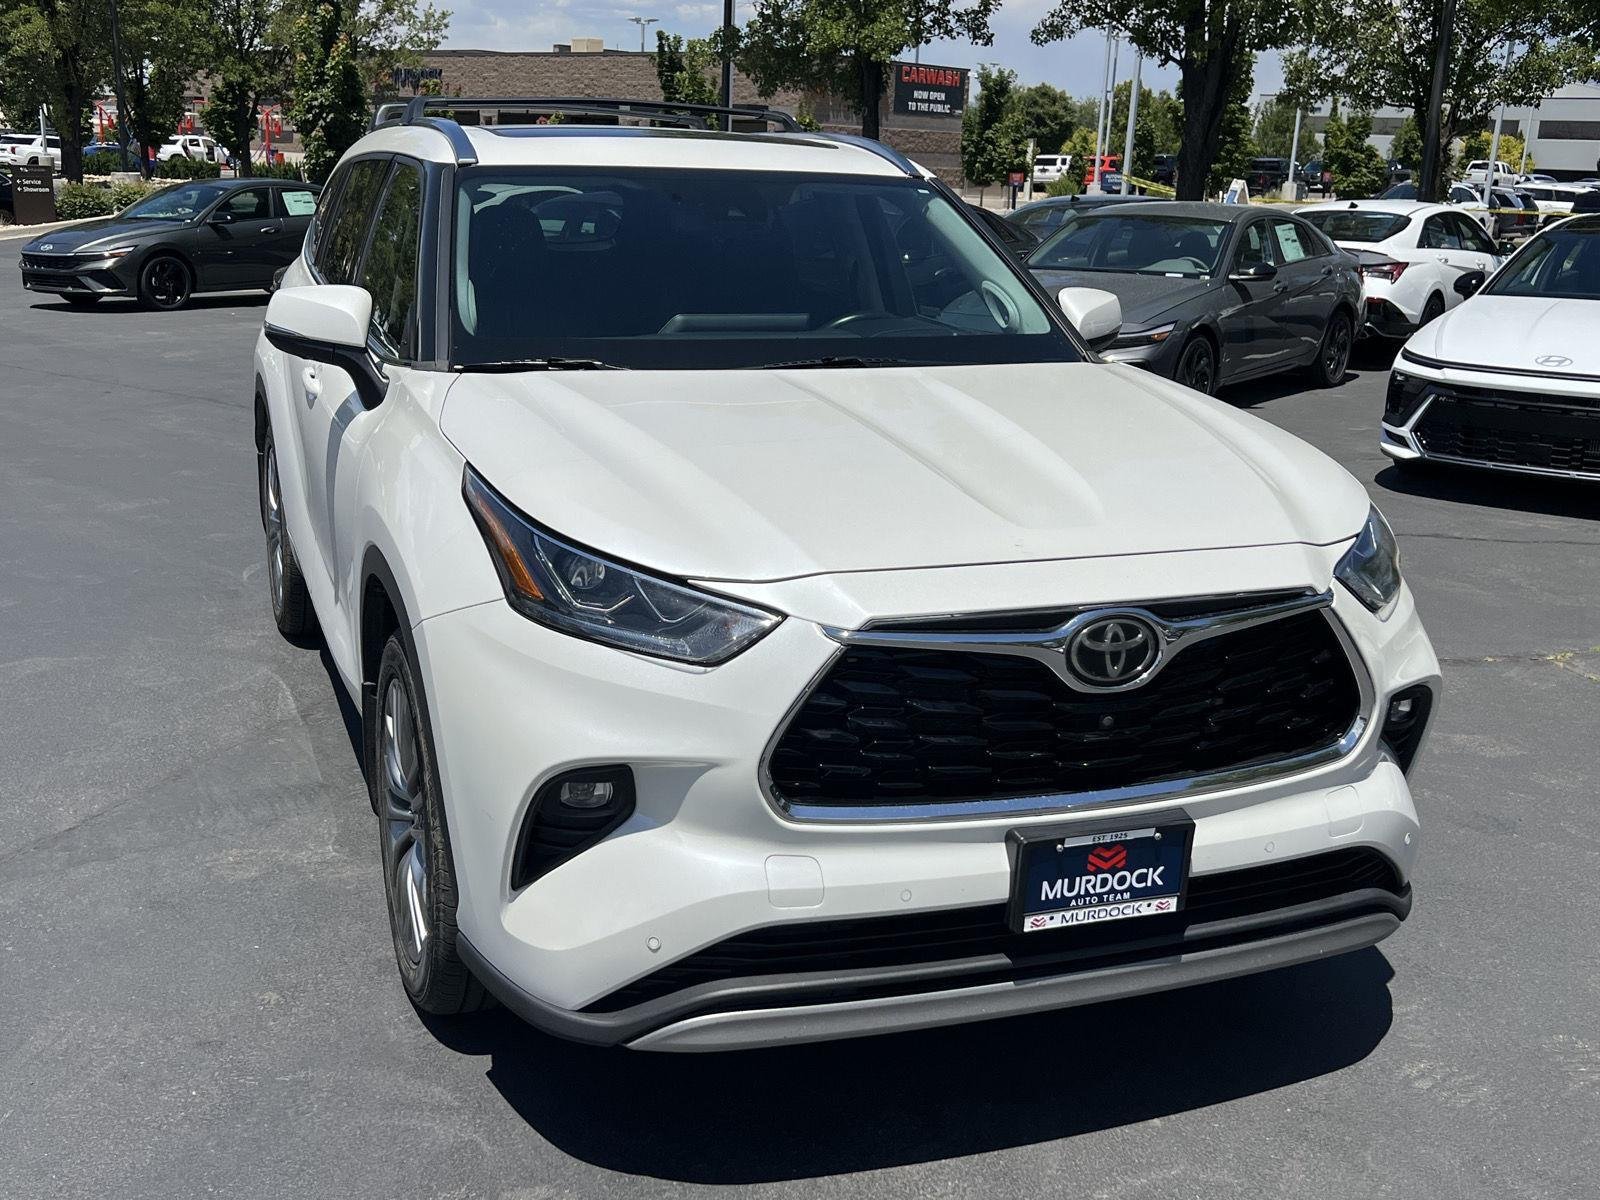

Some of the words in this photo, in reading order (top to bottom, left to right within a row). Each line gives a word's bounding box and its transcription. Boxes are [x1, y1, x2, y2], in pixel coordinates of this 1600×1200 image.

[901, 65, 960, 87] CARWASH
[913, 90, 928, 100] NOW
[929, 91, 945, 101] OPEN
[908, 101, 917, 110] TO
[917, 102, 928, 112] THE
[929, 103, 951, 113] PUBLIC
[1110, 832, 1128, 841] 1925
[1040, 866, 1165, 901] MURDOCK
[1070, 896, 1099, 907] AUTO
[1102, 892, 1131, 902] TEAM
[1060, 901, 1144, 925] MURDOCK
